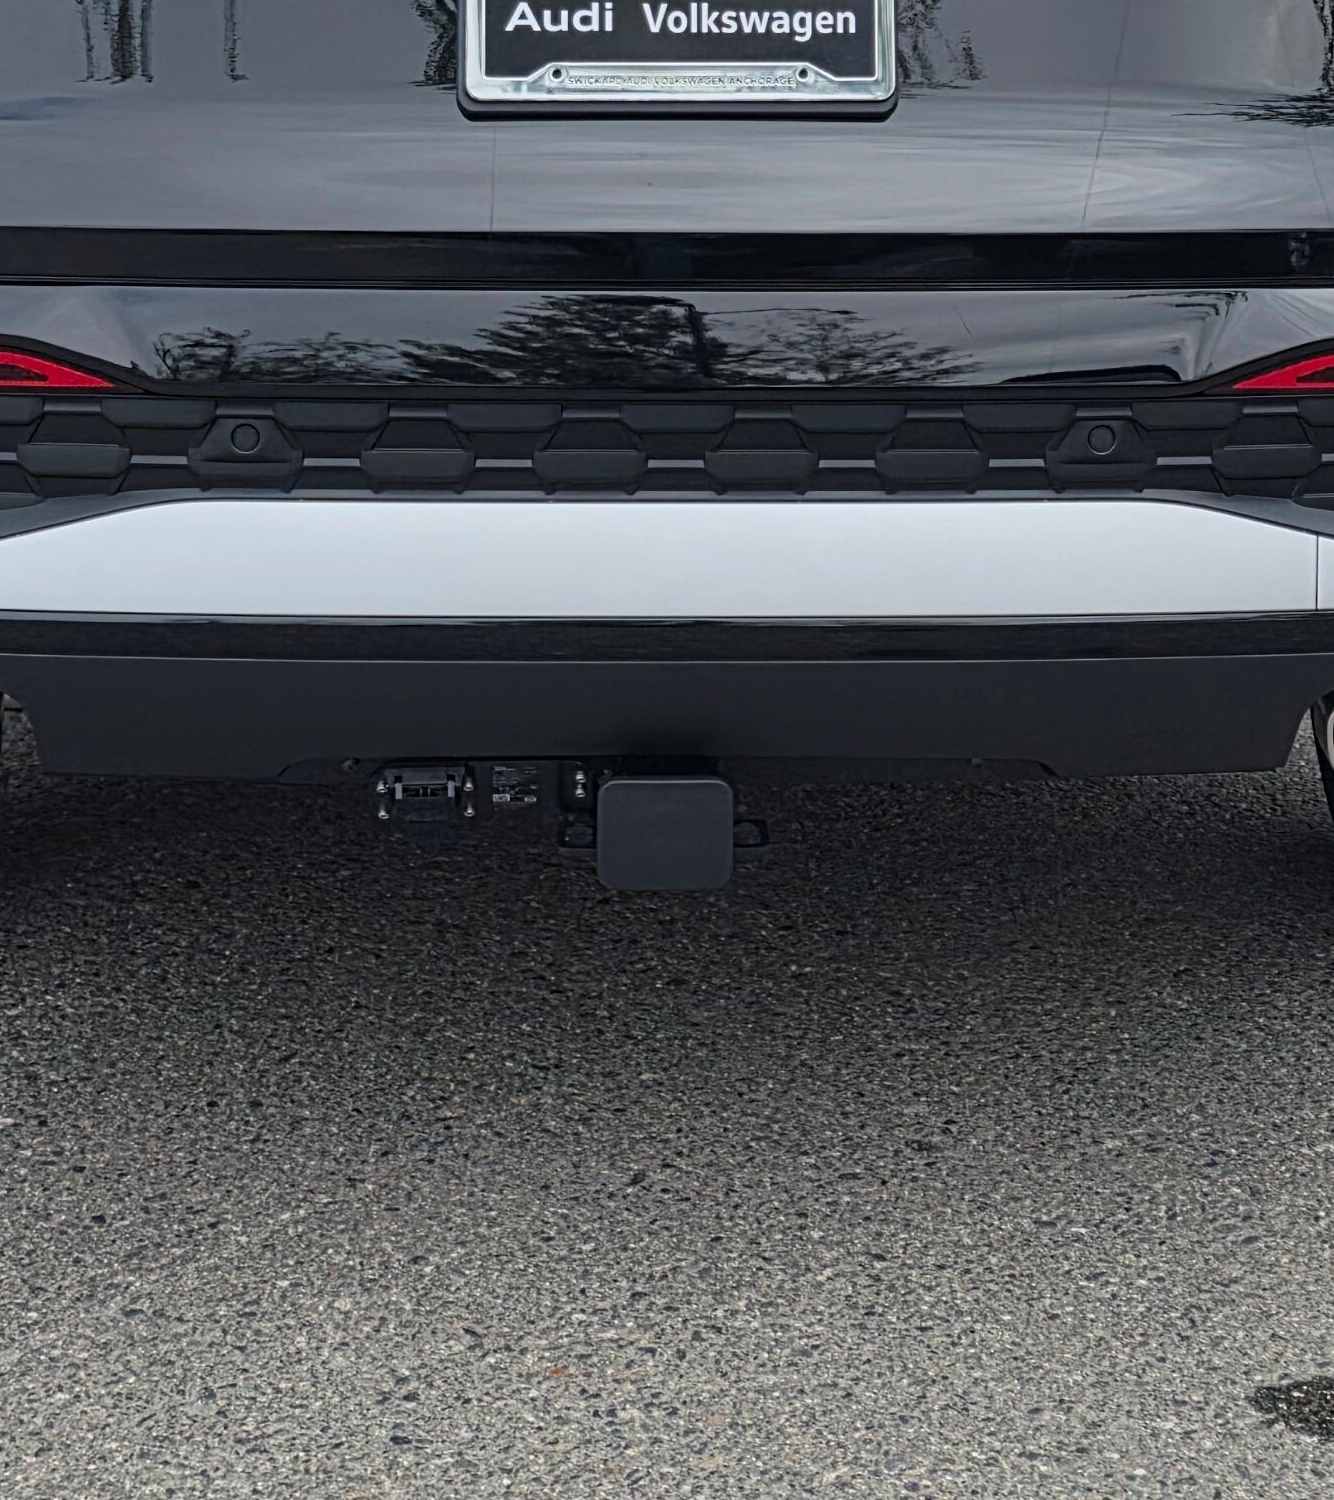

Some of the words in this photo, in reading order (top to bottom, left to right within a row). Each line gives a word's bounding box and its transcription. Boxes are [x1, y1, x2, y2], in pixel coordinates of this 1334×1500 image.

[504, 1, 614, 33] Audi
[642, 2, 857, 42] Volkswagen
[653, 75, 725, 87] VOLKSWAGEN
[728, 75, 794, 87] ANCHORAGE
